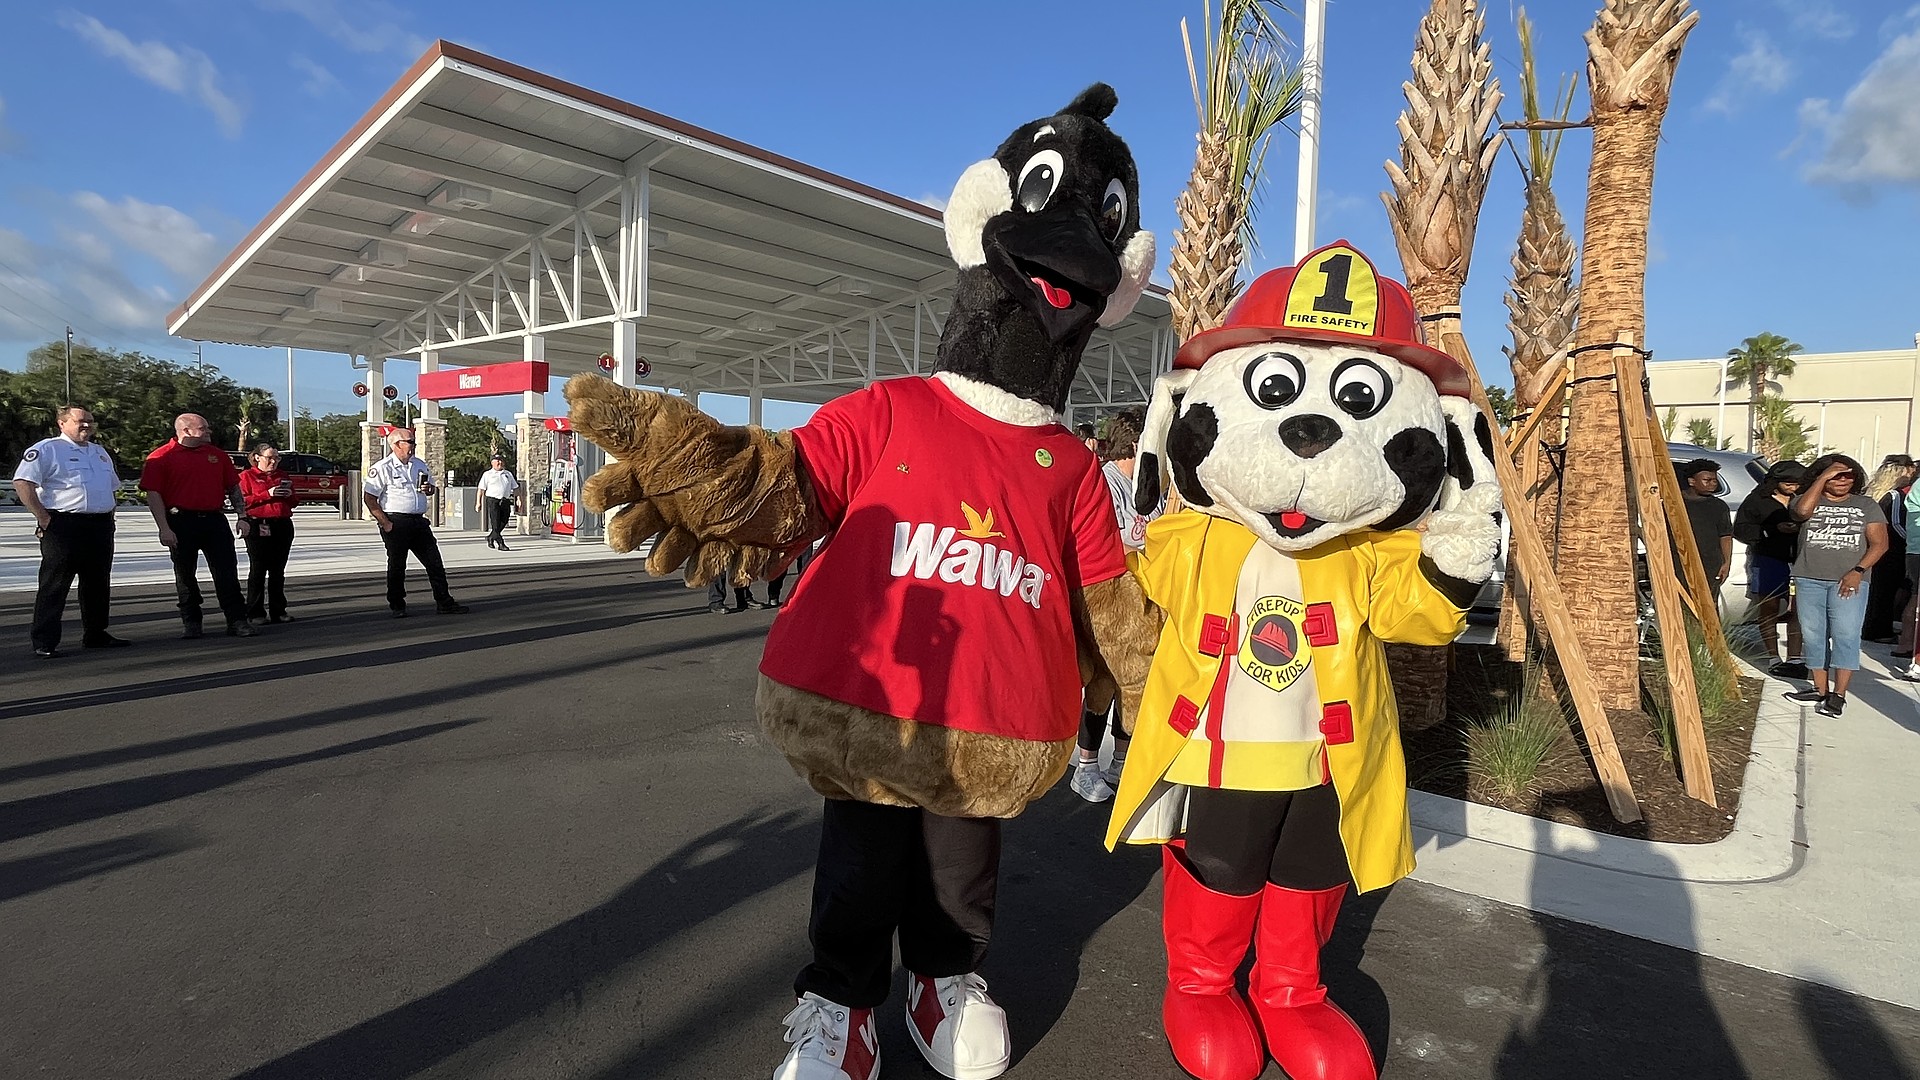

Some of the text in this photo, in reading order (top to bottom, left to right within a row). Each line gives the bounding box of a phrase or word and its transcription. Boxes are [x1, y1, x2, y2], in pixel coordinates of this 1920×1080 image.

[1313, 254, 1352, 315] 1
[1290, 314, 1368, 330] FIRE SAFETY
[605, 358, 611, 368] 1
[638, 362, 645, 372] 2
[459, 373, 482, 389] Wawa
[358, 386, 364, 394] 9
[1806, 529, 1861, 546] PERFECTLY
[890, 521, 1045, 609] Wawa
[1246, 659, 1304, 684] FOR KIDS
